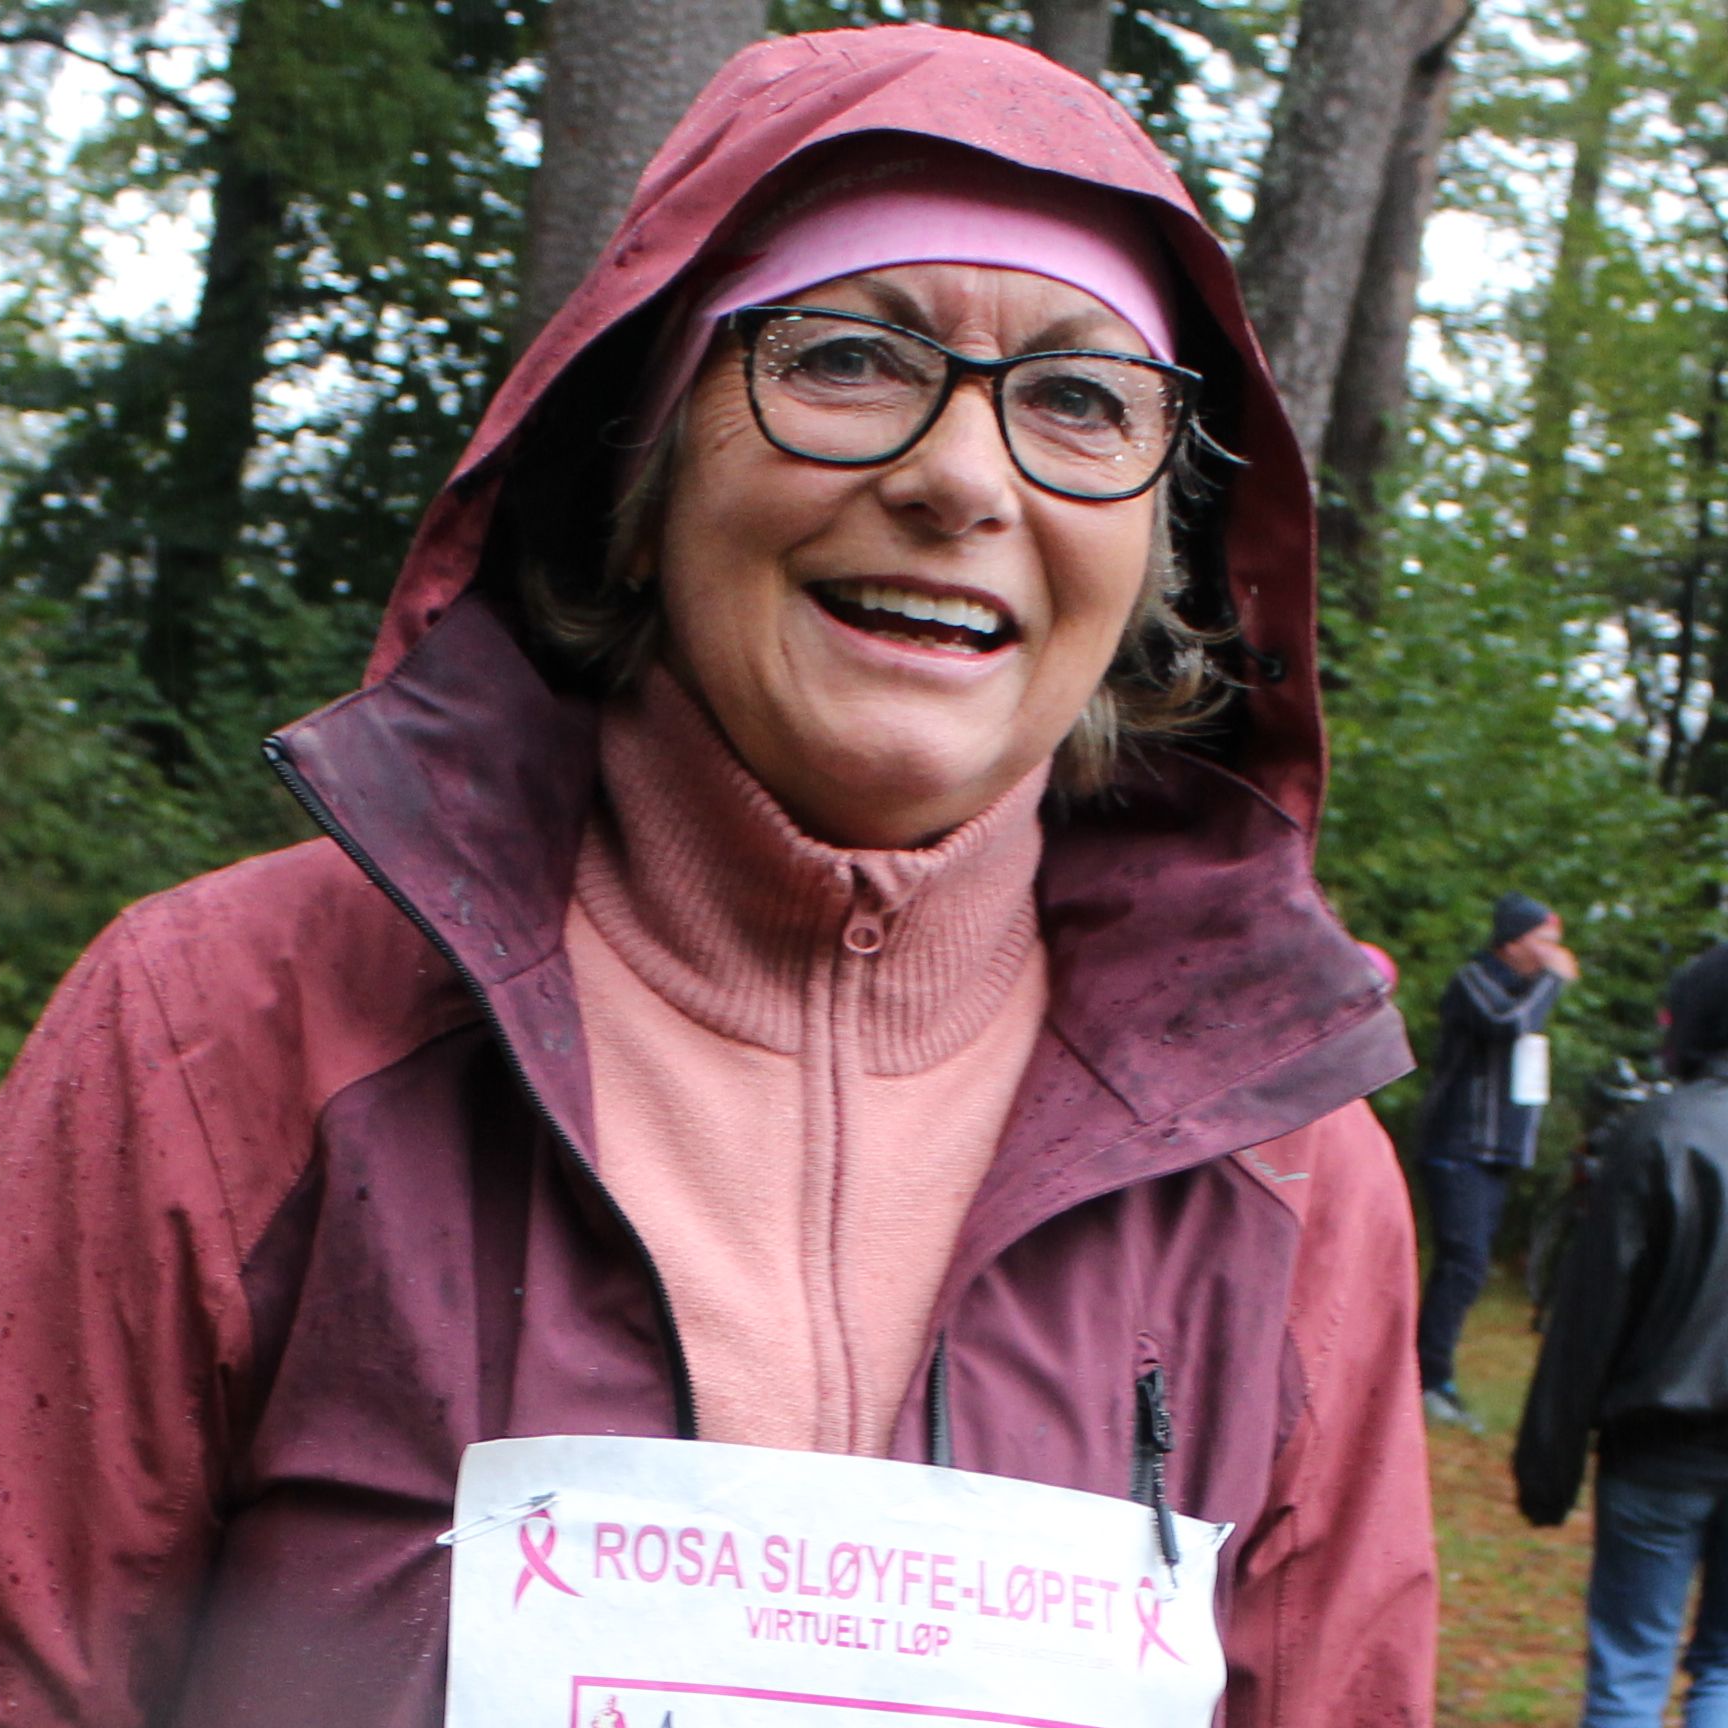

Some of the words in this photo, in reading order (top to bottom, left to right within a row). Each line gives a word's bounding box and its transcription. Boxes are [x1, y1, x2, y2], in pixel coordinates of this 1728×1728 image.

[593, 1522, 745, 1589] ROSA
[761, 1534, 1120, 1633] SLØYFE-LØPET
[744, 1605, 888, 1651] VIRTUELT
[896, 1621, 952, 1657] LØP
